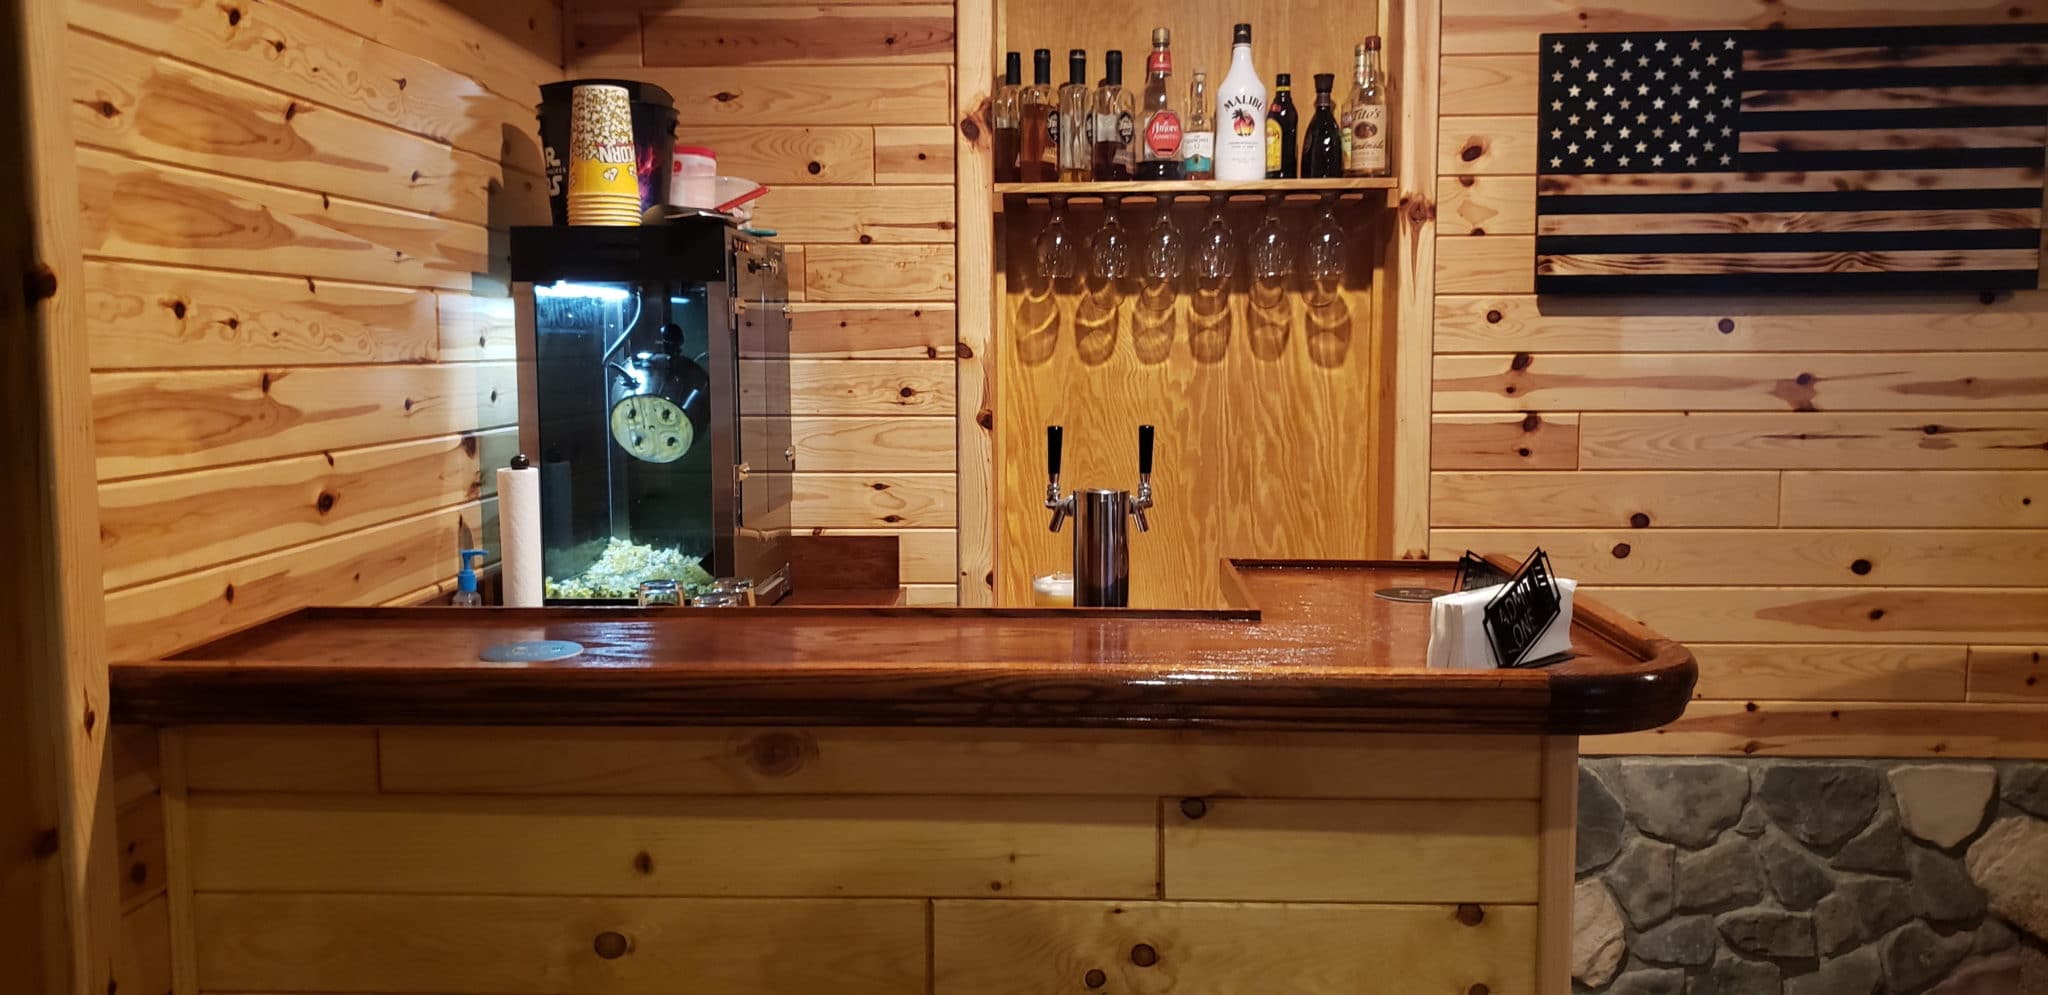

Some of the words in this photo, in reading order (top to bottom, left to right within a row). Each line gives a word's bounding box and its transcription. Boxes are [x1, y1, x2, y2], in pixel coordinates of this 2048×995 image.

[1223, 95, 1265, 113] MALIBU
[1353, 108, 1382, 121] Tito's
[1499, 575, 1532, 625] ADMIT
[1512, 607, 1538, 648] ONE
